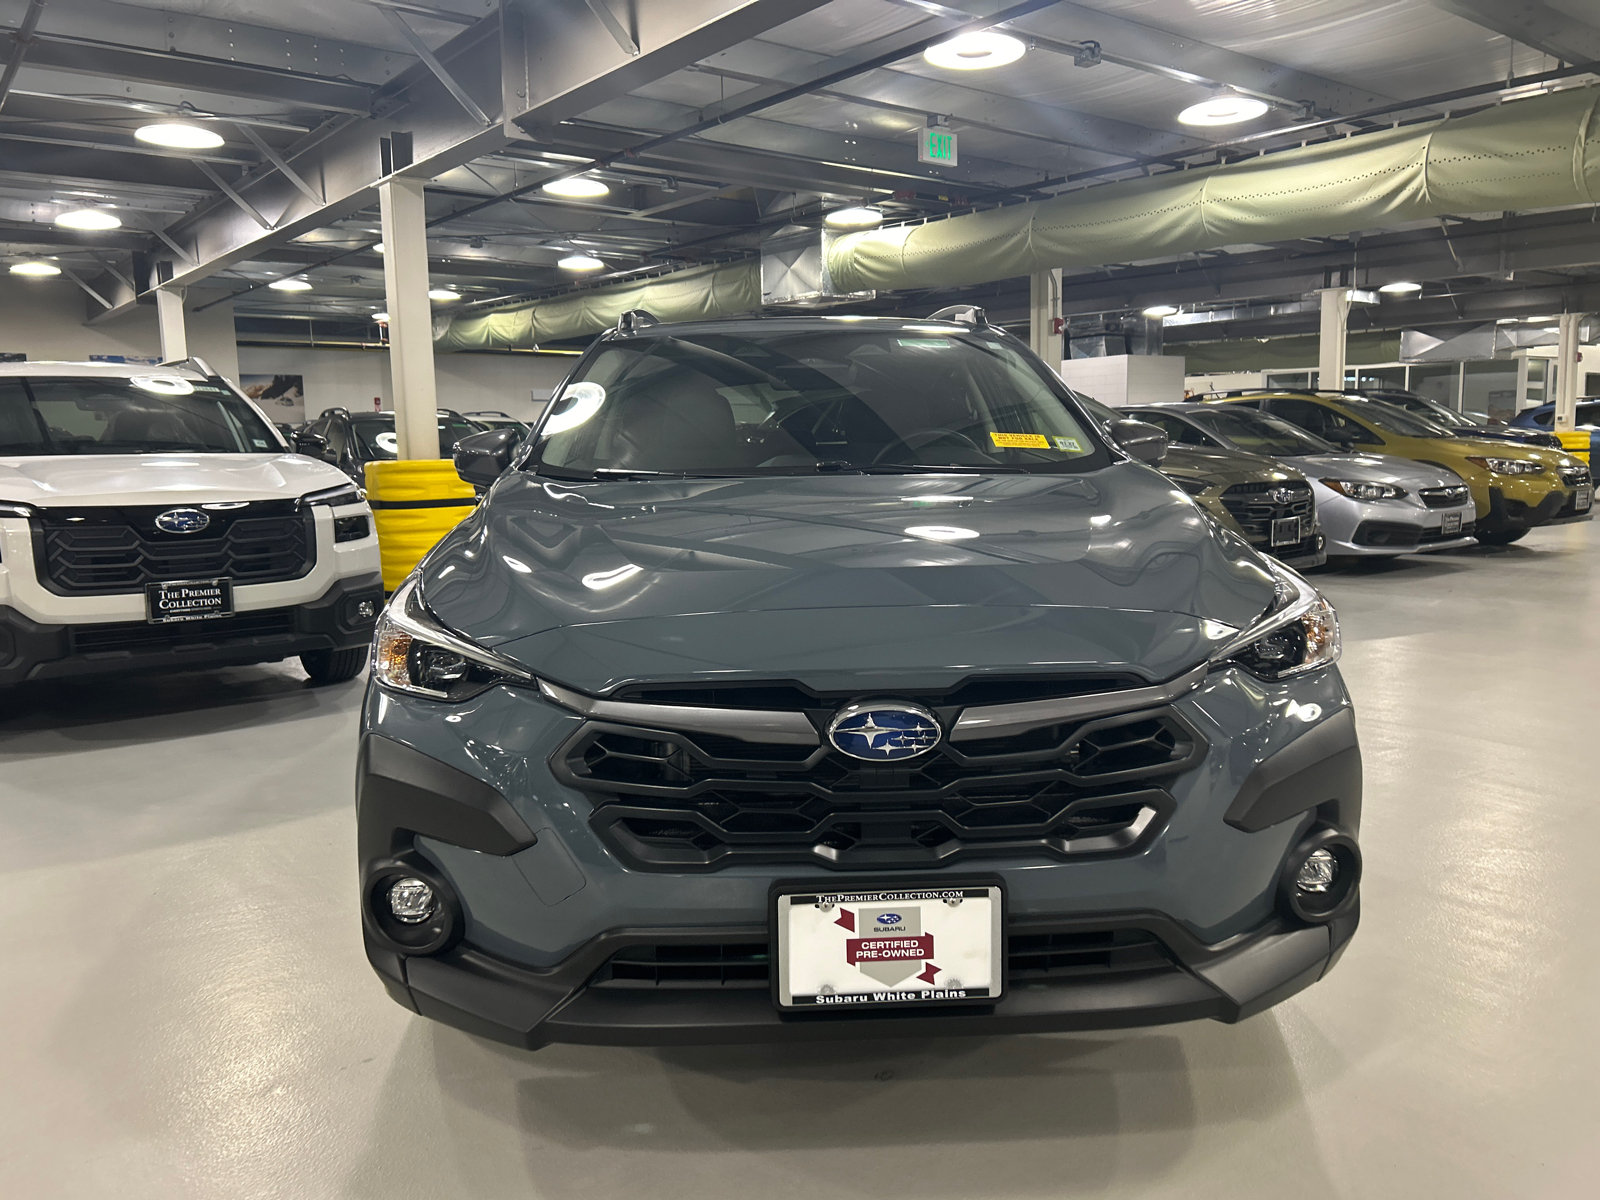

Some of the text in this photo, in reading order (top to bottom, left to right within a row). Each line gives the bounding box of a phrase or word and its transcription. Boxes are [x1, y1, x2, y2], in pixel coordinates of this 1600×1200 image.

[930, 132, 952, 160] EXIT
[158, 588, 222, 600] THE PREMIER
[158, 598, 222, 610] COLLECTION
[862, 940, 918, 950] CERTIFIED
[856, 948, 924, 959] PRE-OWNED
[816, 989, 966, 1004] Subaru White Plains
